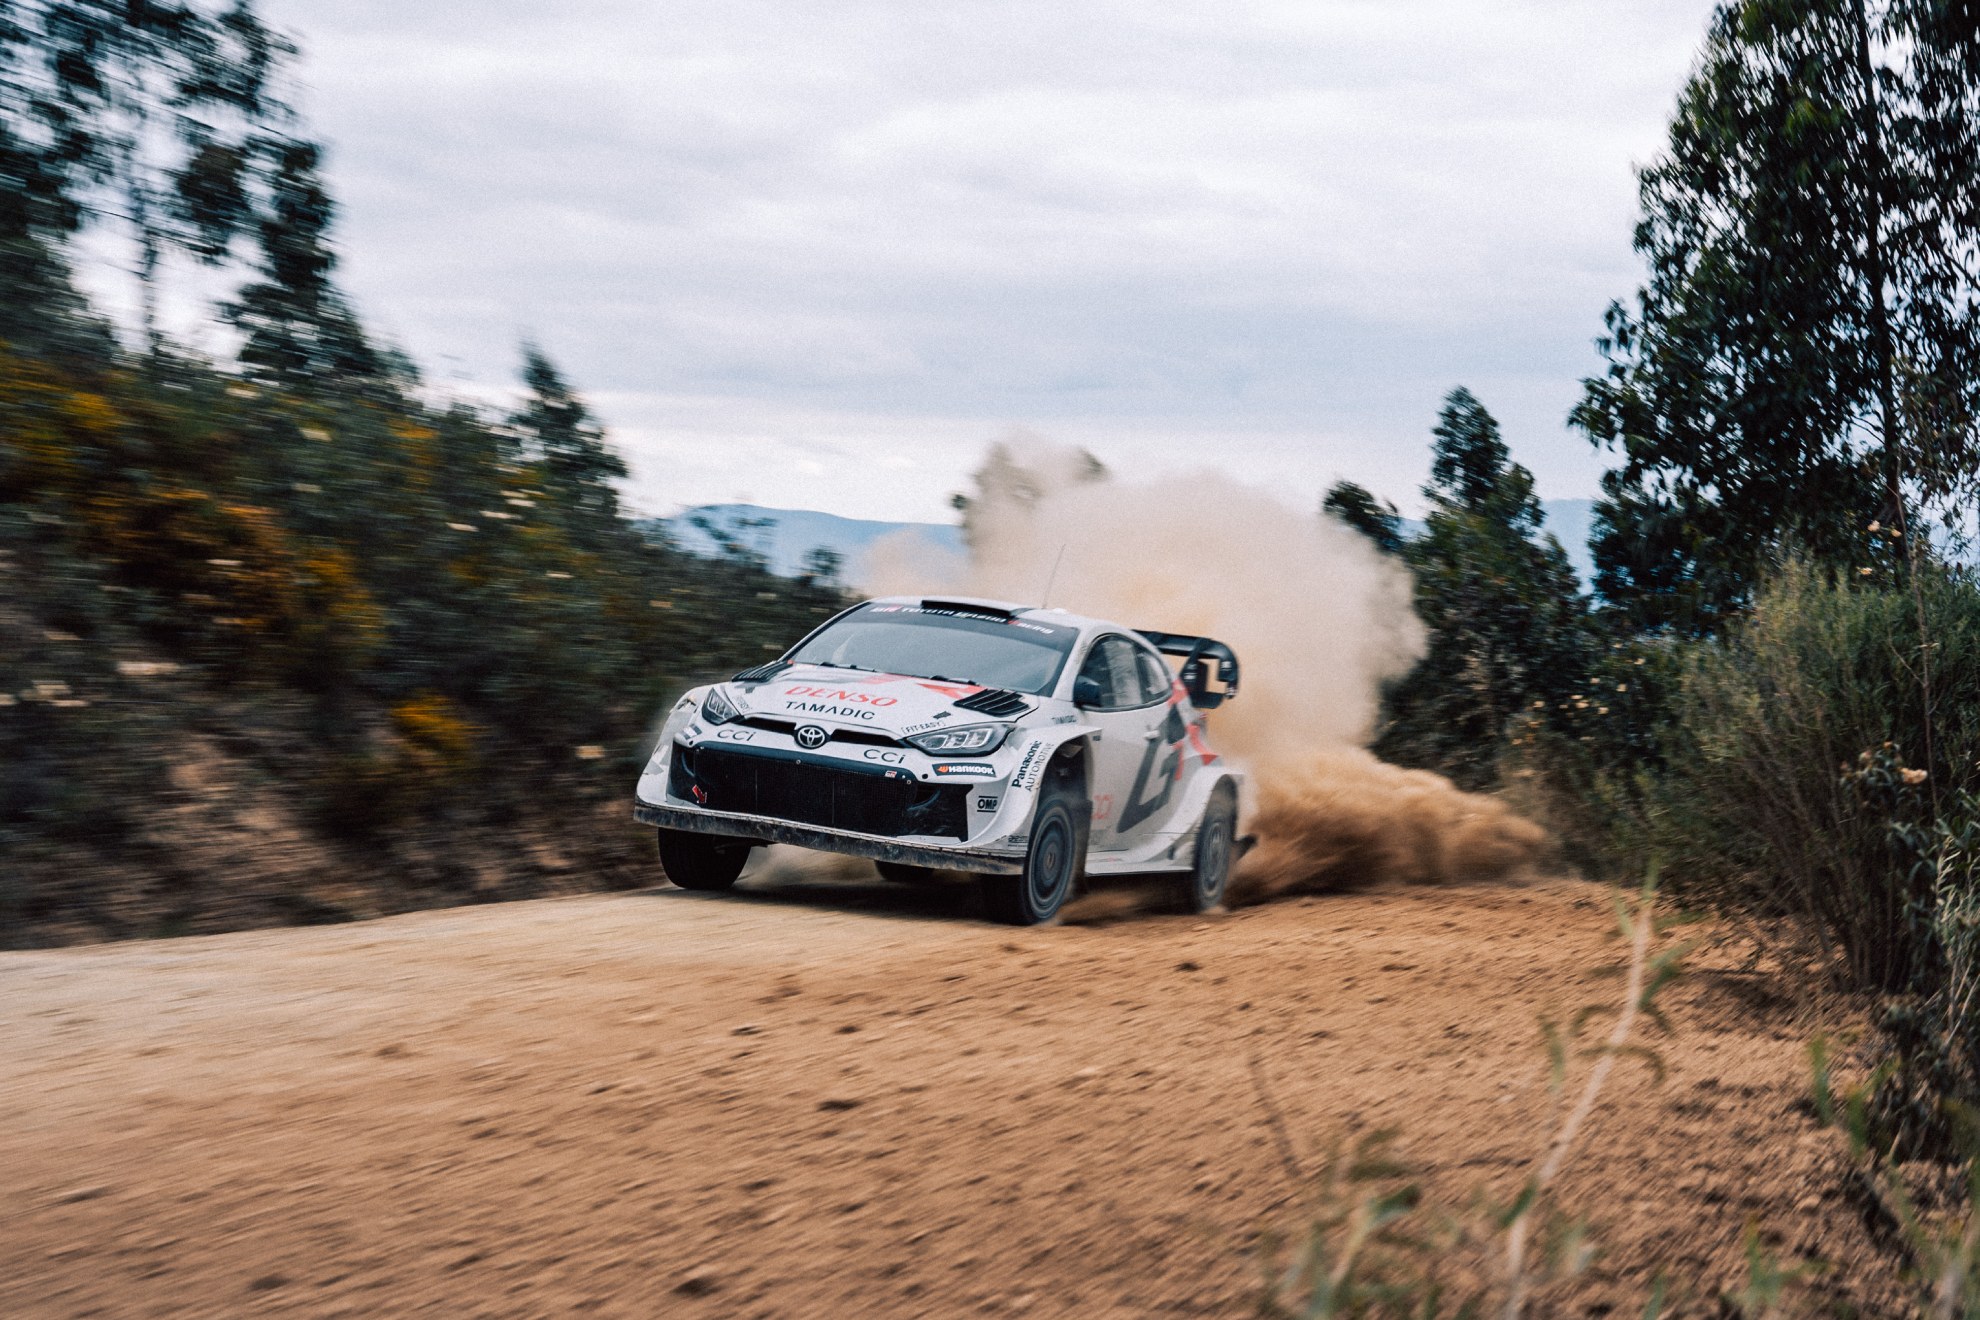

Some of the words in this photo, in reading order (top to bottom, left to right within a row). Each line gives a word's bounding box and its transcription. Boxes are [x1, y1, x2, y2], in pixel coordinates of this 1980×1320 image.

[785, 686, 898, 707] DENSO
[785, 701, 876, 721] TAMADIC
[1011, 740, 1042, 788] Panasonic
[1024, 742, 1055, 792] AUTOMOTIVE
[977, 798, 998, 810] OMP
